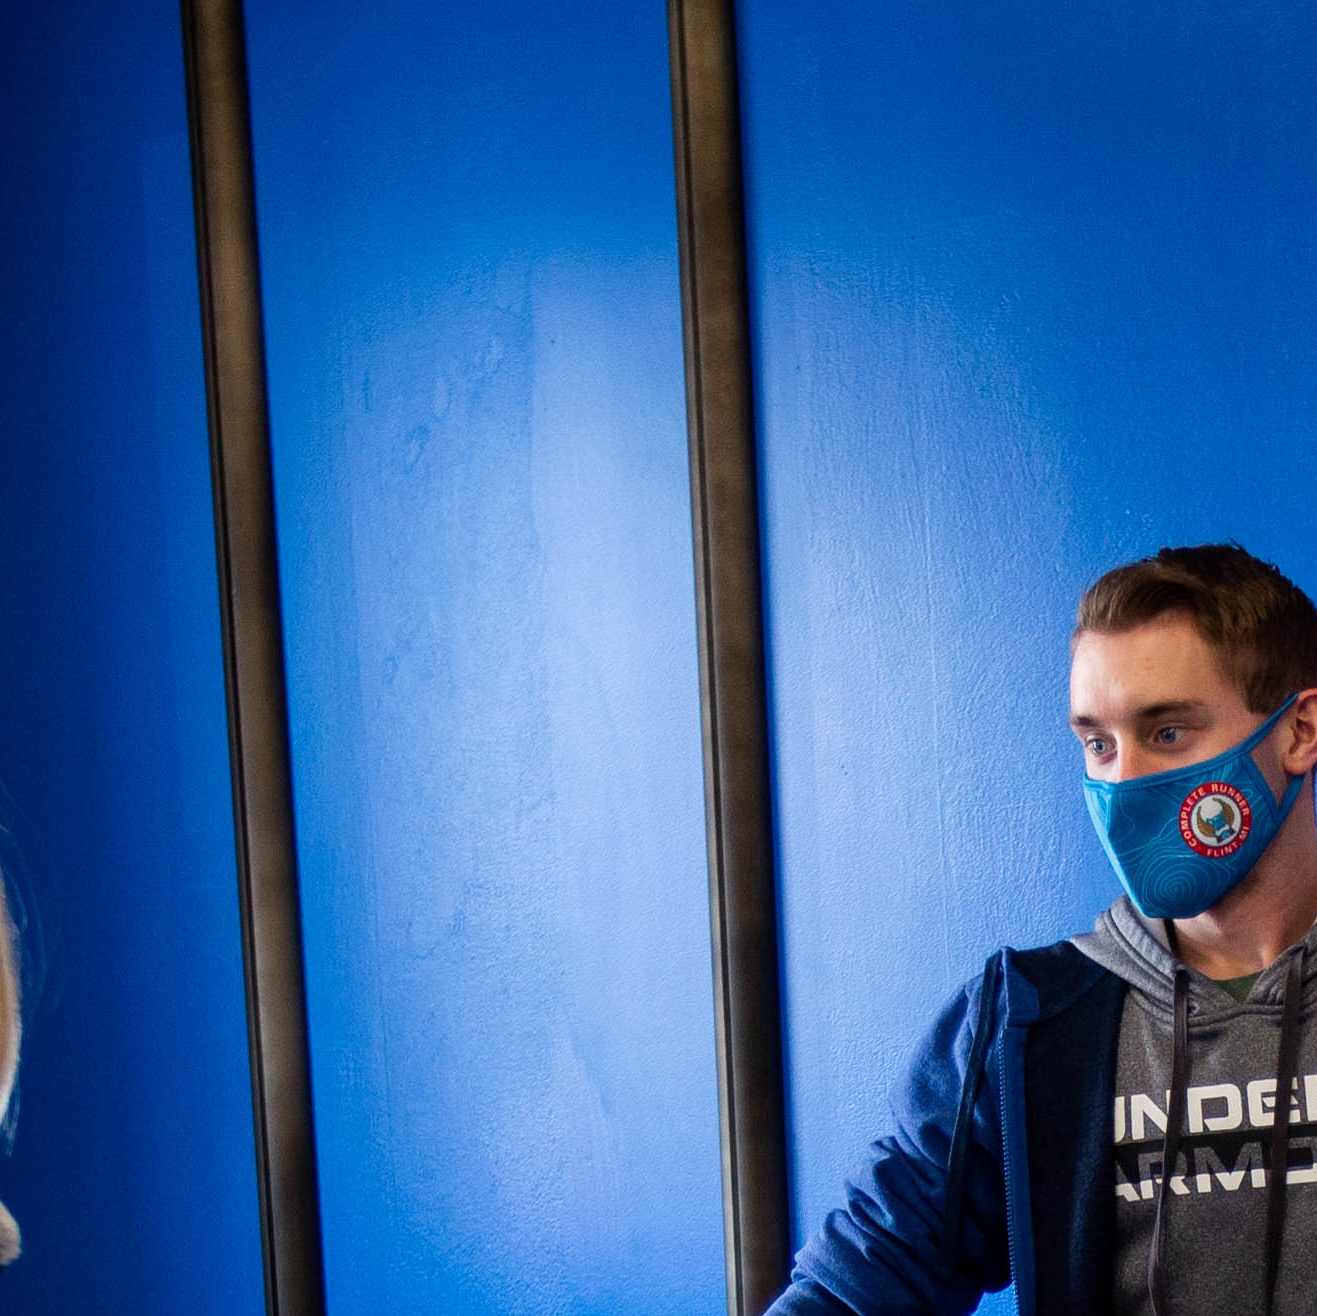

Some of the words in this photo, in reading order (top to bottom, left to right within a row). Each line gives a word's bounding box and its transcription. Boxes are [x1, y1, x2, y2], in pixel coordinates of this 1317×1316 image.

[1180, 787, 1205, 847] COMPLETE
[1211, 783, 1250, 816] RUNNER
[1207, 841, 1238, 857] FLINT
